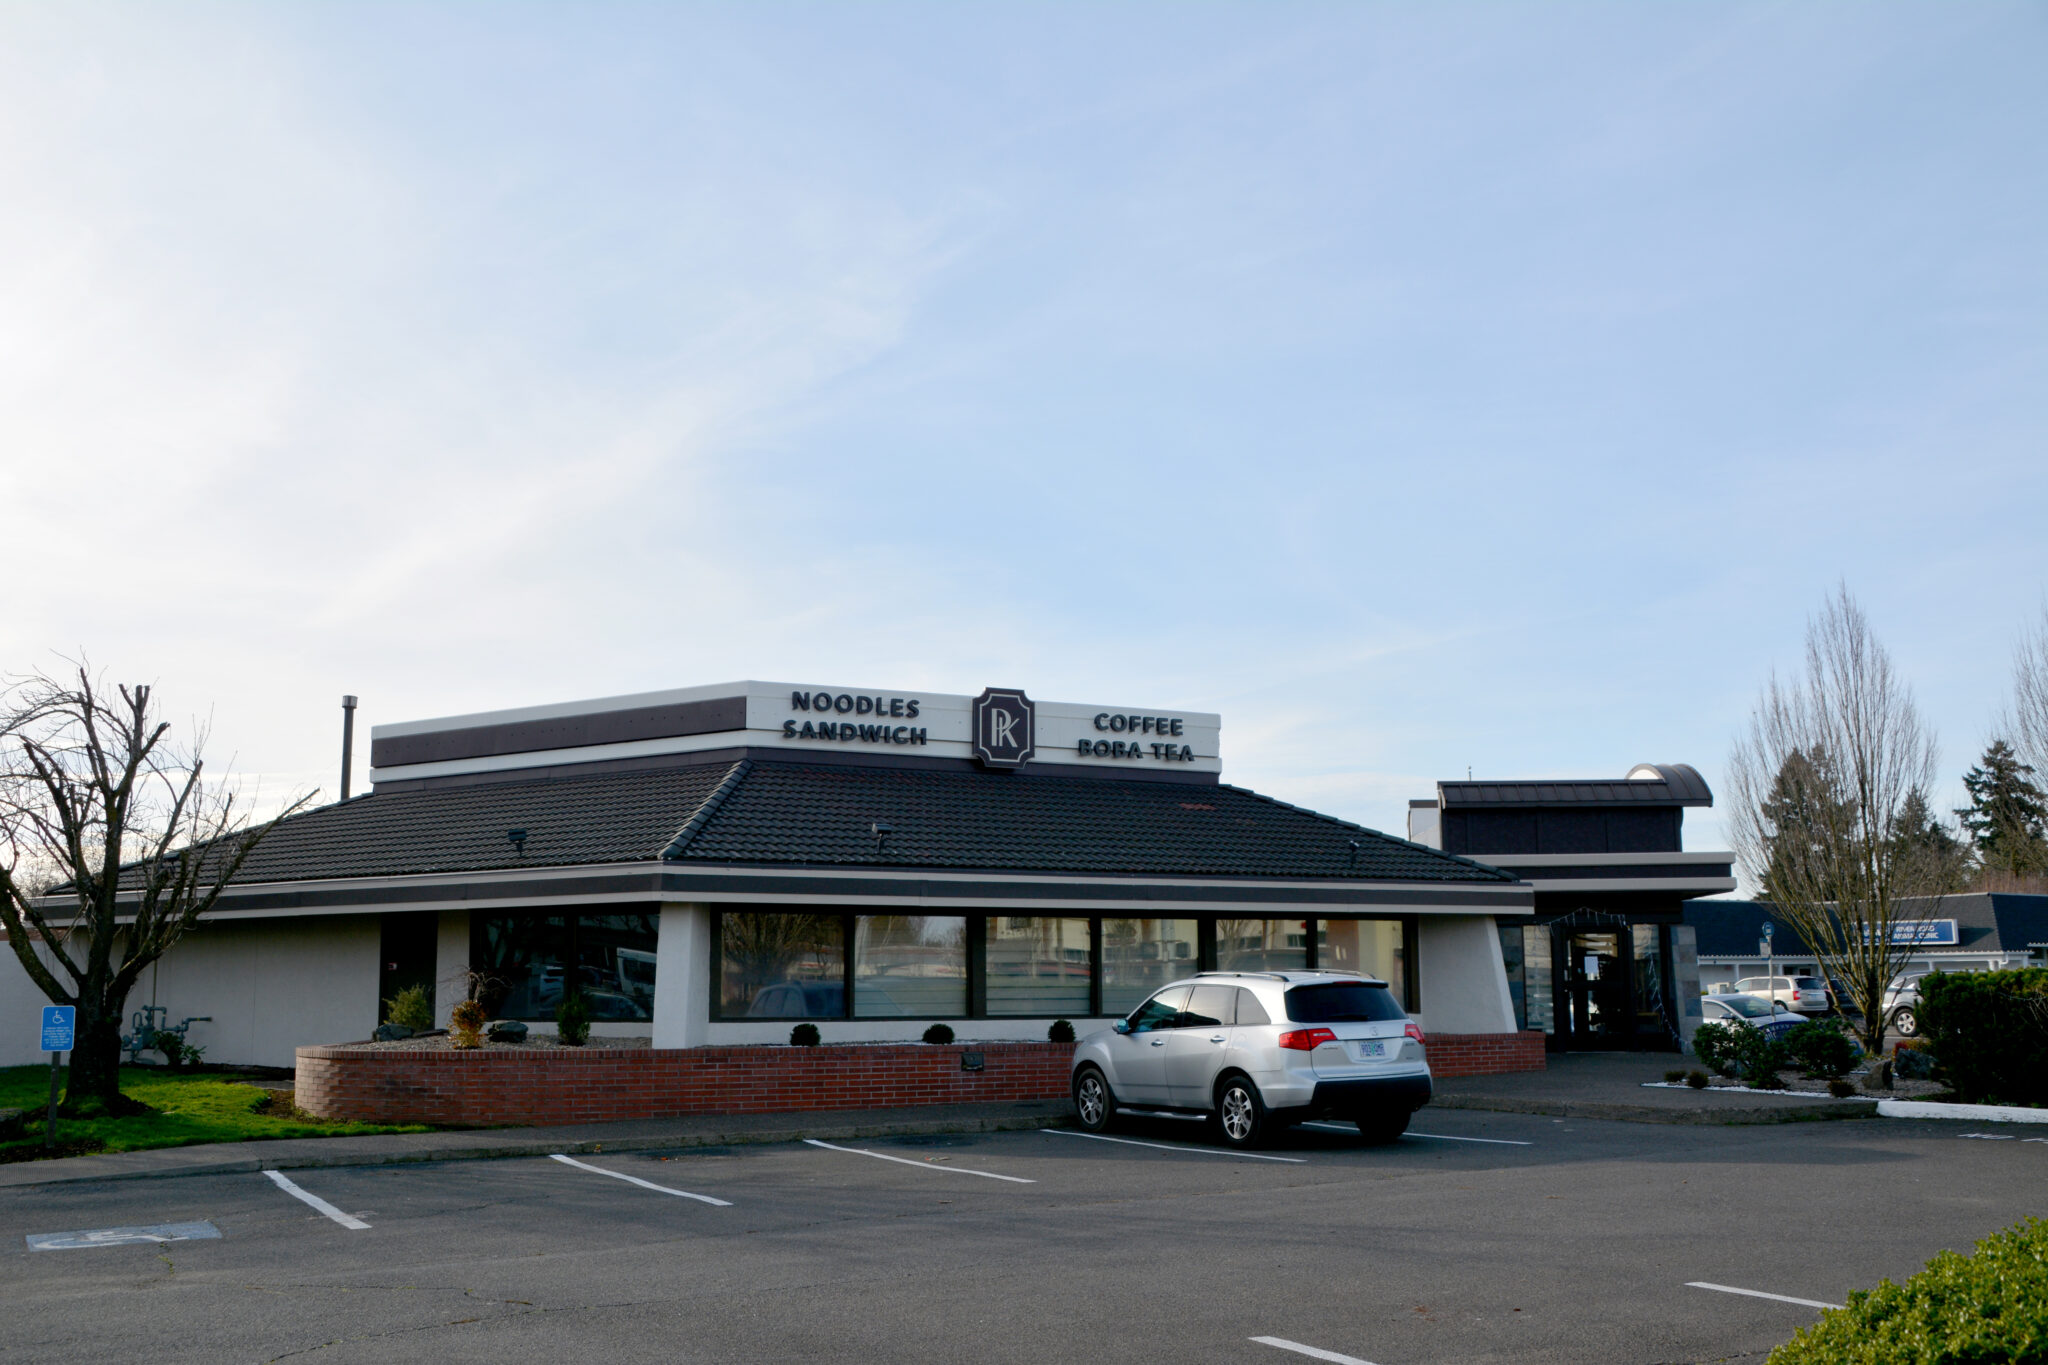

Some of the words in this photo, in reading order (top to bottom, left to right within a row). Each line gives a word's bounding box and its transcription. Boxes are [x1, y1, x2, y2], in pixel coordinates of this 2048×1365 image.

[792, 691, 920, 718] NOODLES
[783, 719, 927, 745] SANDWICH
[1094, 713, 1184, 736] COFFEE
[1079, 739, 1144, 759] BOBA
[1151, 742, 1195, 762] TEA
